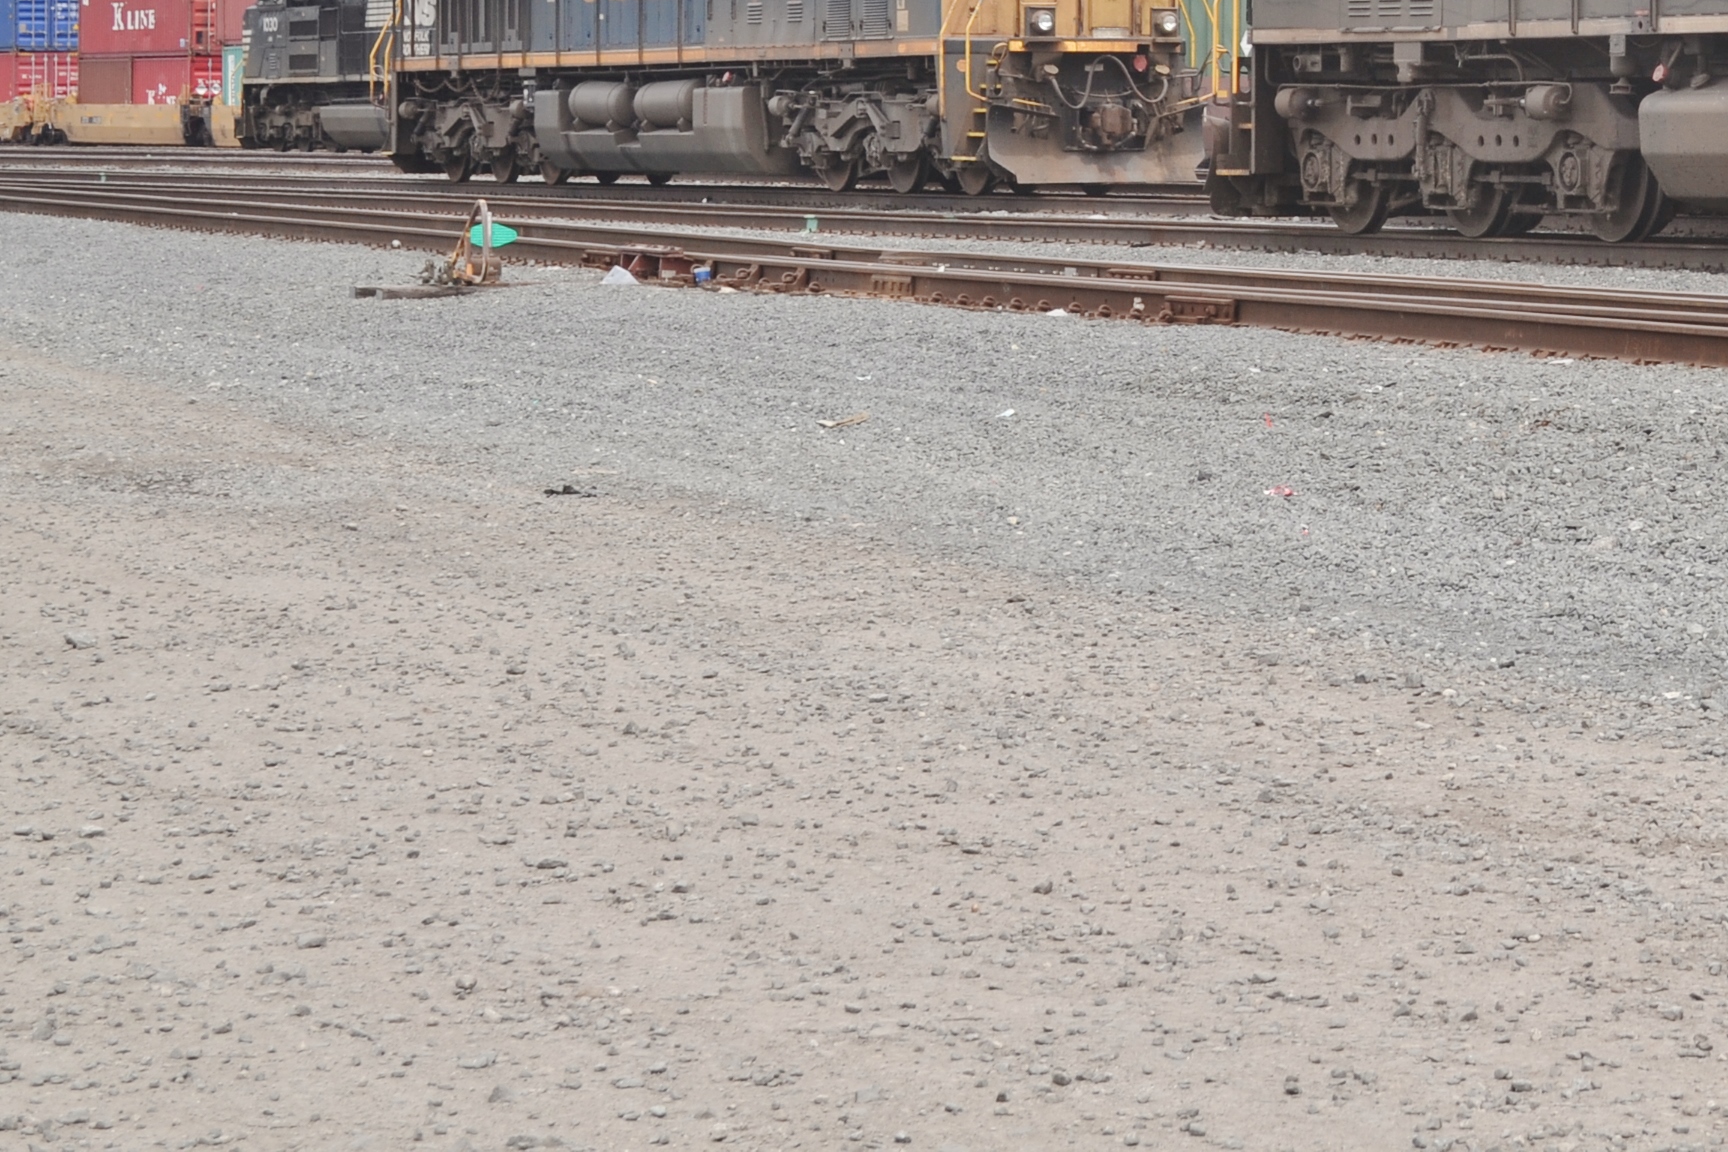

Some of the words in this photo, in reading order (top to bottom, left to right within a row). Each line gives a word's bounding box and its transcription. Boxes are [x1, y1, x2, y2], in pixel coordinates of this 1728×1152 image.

[111, 2, 125, 30] K
[126, 9, 155, 30] LINE
[263, 16, 278, 32] 1030
[402, 29, 430, 42] NOFOLK
